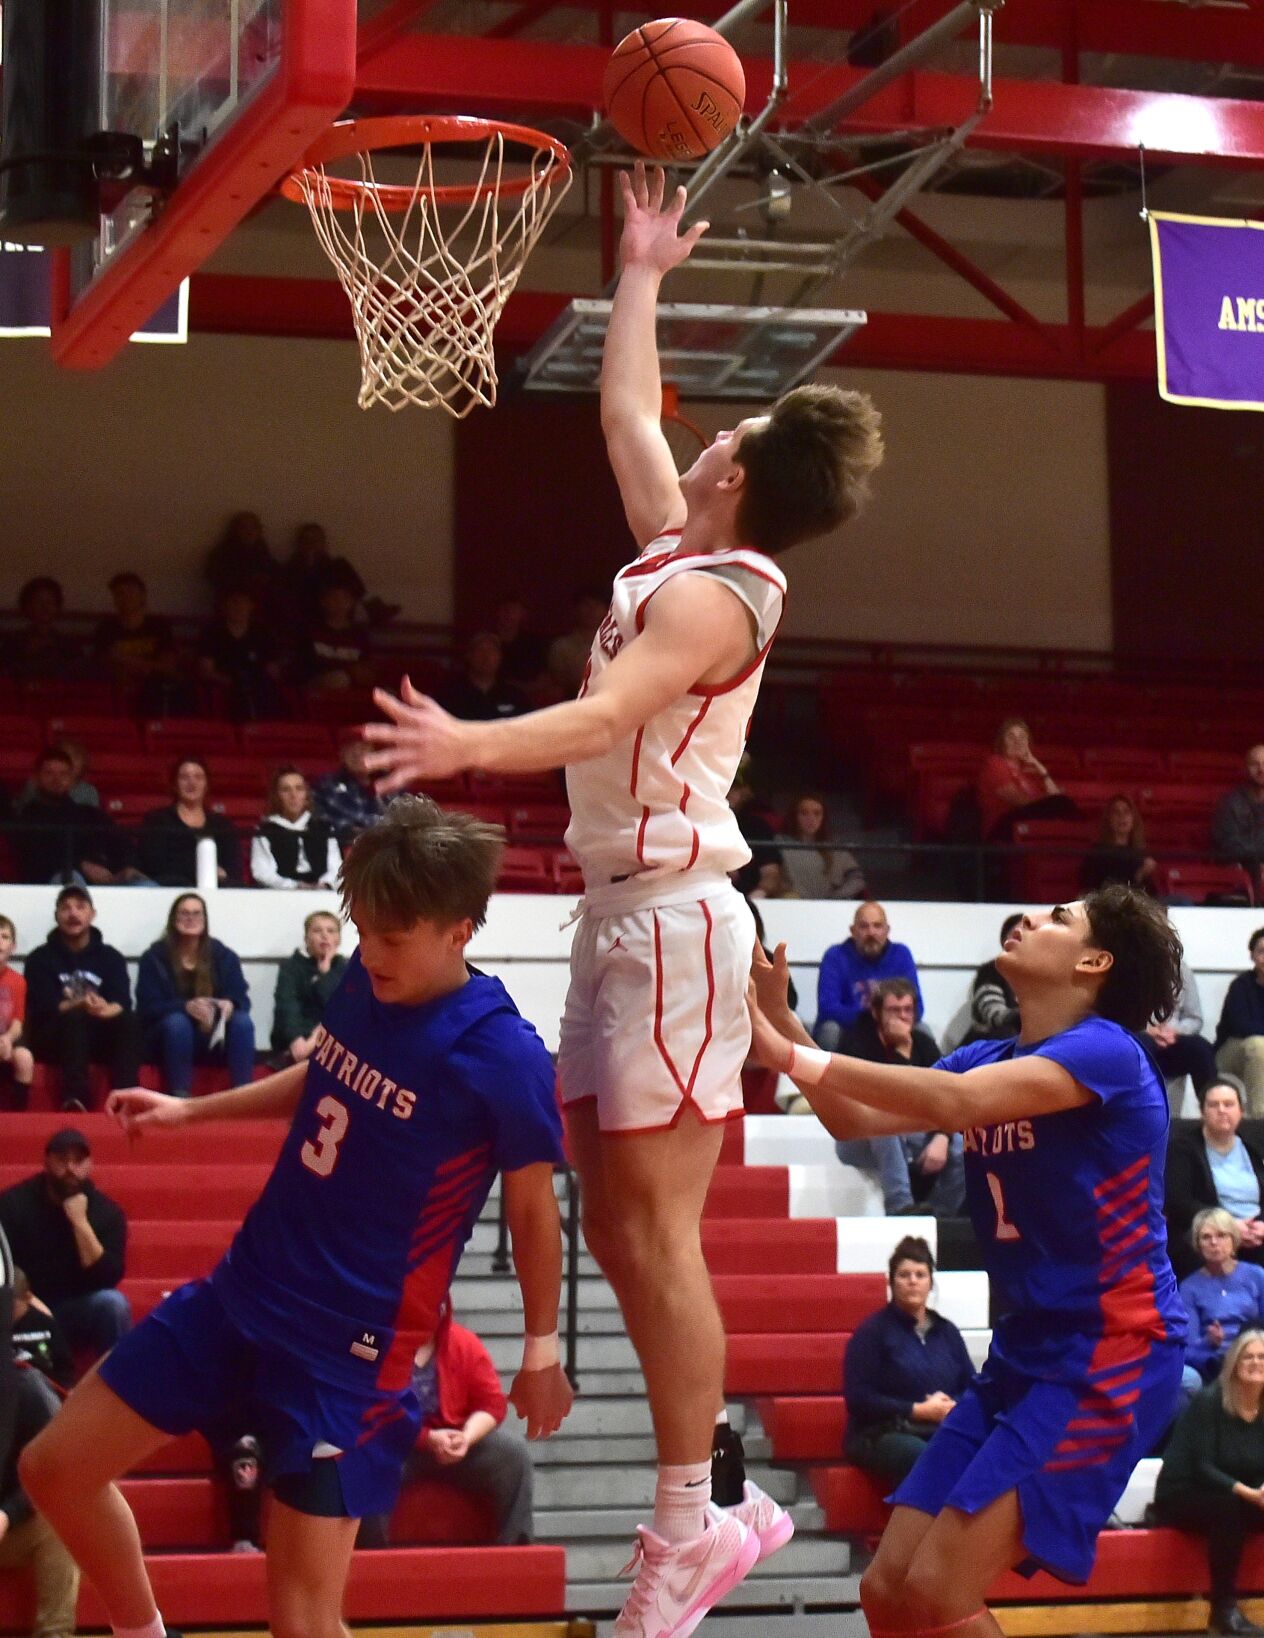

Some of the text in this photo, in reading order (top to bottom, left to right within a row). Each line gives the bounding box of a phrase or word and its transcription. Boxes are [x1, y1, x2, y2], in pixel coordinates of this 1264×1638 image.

[305, 1022, 417, 1120] PATRIOTS
[300, 1094, 349, 1177] 3
[986, 1171, 1020, 1239] 1
[362, 1332, 375, 1345] M
